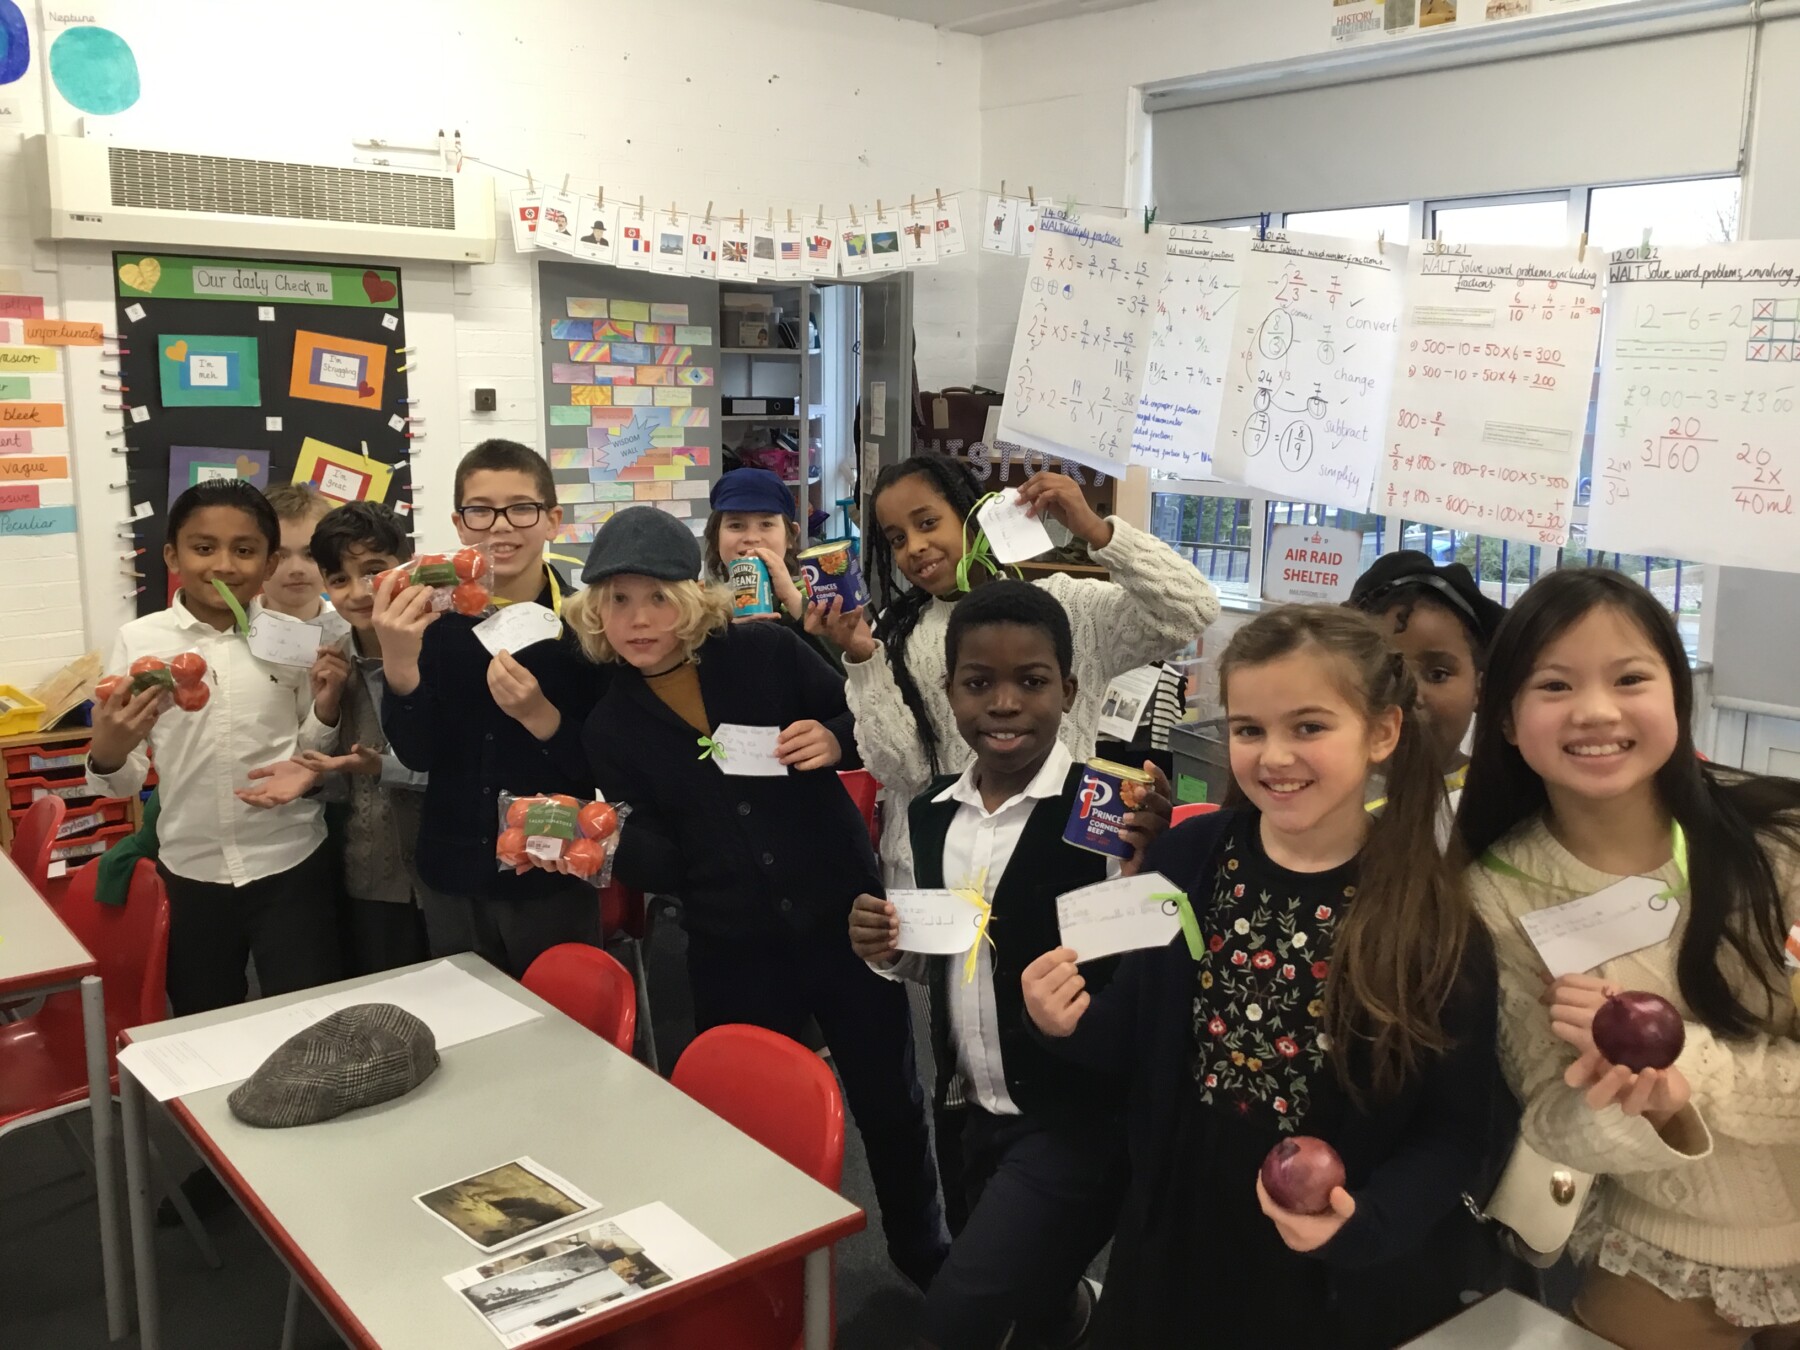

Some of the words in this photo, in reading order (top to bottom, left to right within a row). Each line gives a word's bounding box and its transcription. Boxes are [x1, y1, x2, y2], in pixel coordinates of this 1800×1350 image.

[49, 11, 96, 25] Neptune
[1337, 10, 1373, 25] HISTORY
[1253, 242, 1276, 252] WALT
[1423, 259, 1456, 273] WALT
[1459, 260, 1483, 274] Solve
[1487, 264, 1513, 277] word
[1516, 263, 1552, 281] problems
[1553, 266, 1598, 289] including
[1610, 264, 1645, 282] WALT
[1644, 261, 1672, 280] Solve
[1675, 264, 1701, 280] word
[1743, 262, 1795, 287] involving
[197, 270, 226, 288] Our
[232, 268, 268, 297] daily
[275, 274, 314, 296] Check
[316, 281, 328, 293] in
[26, 324, 101, 345] unfortunate
[329, 355, 343, 365] I'm
[1536, 346, 1561, 362] 300
[199, 358, 215, 368] I'm
[198, 371, 218, 380] meh
[1334, 368, 1375, 397] change
[1532, 373, 1556, 388] 200
[1324, 419, 1369, 442] subtract
[1668, 416, 1700, 437] 20
[612, 434, 640, 448] WISDOM
[621, 447, 638, 457] WALL
[1668, 443, 1699, 472] 60
[1736, 443, 1771, 465] 20
[2, 463, 48, 478] vague
[332, 469, 347, 481] I'm
[1319, 464, 1360, 489] simplify
[325, 478, 347, 492] great
[0, 514, 57, 532] Peculiar
[1285, 548, 1307, 562] AIR
[1310, 551, 1343, 566] RAID
[733, 565, 752, 574] HEINZ
[1283, 568, 1339, 587] SHELTER
[1087, 826, 1105, 836] BEEF
[1089, 819, 1119, 834] CORNED
